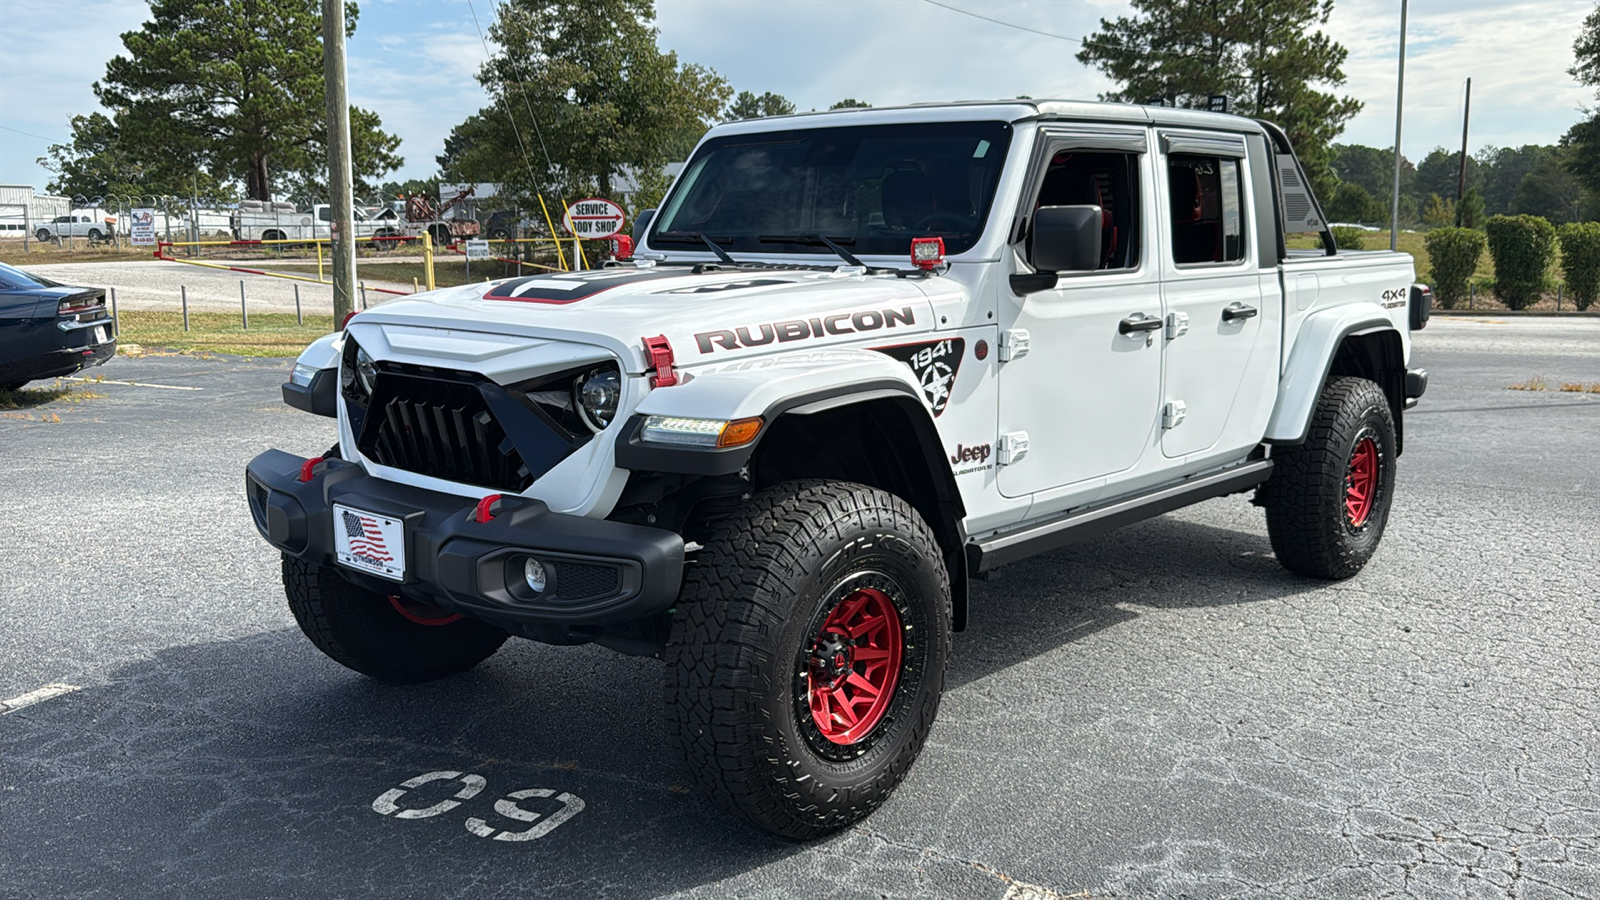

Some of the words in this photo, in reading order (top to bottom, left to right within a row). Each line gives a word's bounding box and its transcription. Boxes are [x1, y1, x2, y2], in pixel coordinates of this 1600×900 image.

[575, 203, 609, 216] SERVICE
[572, 221, 593, 233] BODY
[595, 220, 617, 233] SHOP
[693, 306, 916, 355] RUBICON
[910, 339, 953, 371] 1941
[951, 443, 991, 465] Jeep
[358, 554, 384, 568] THOMSON
